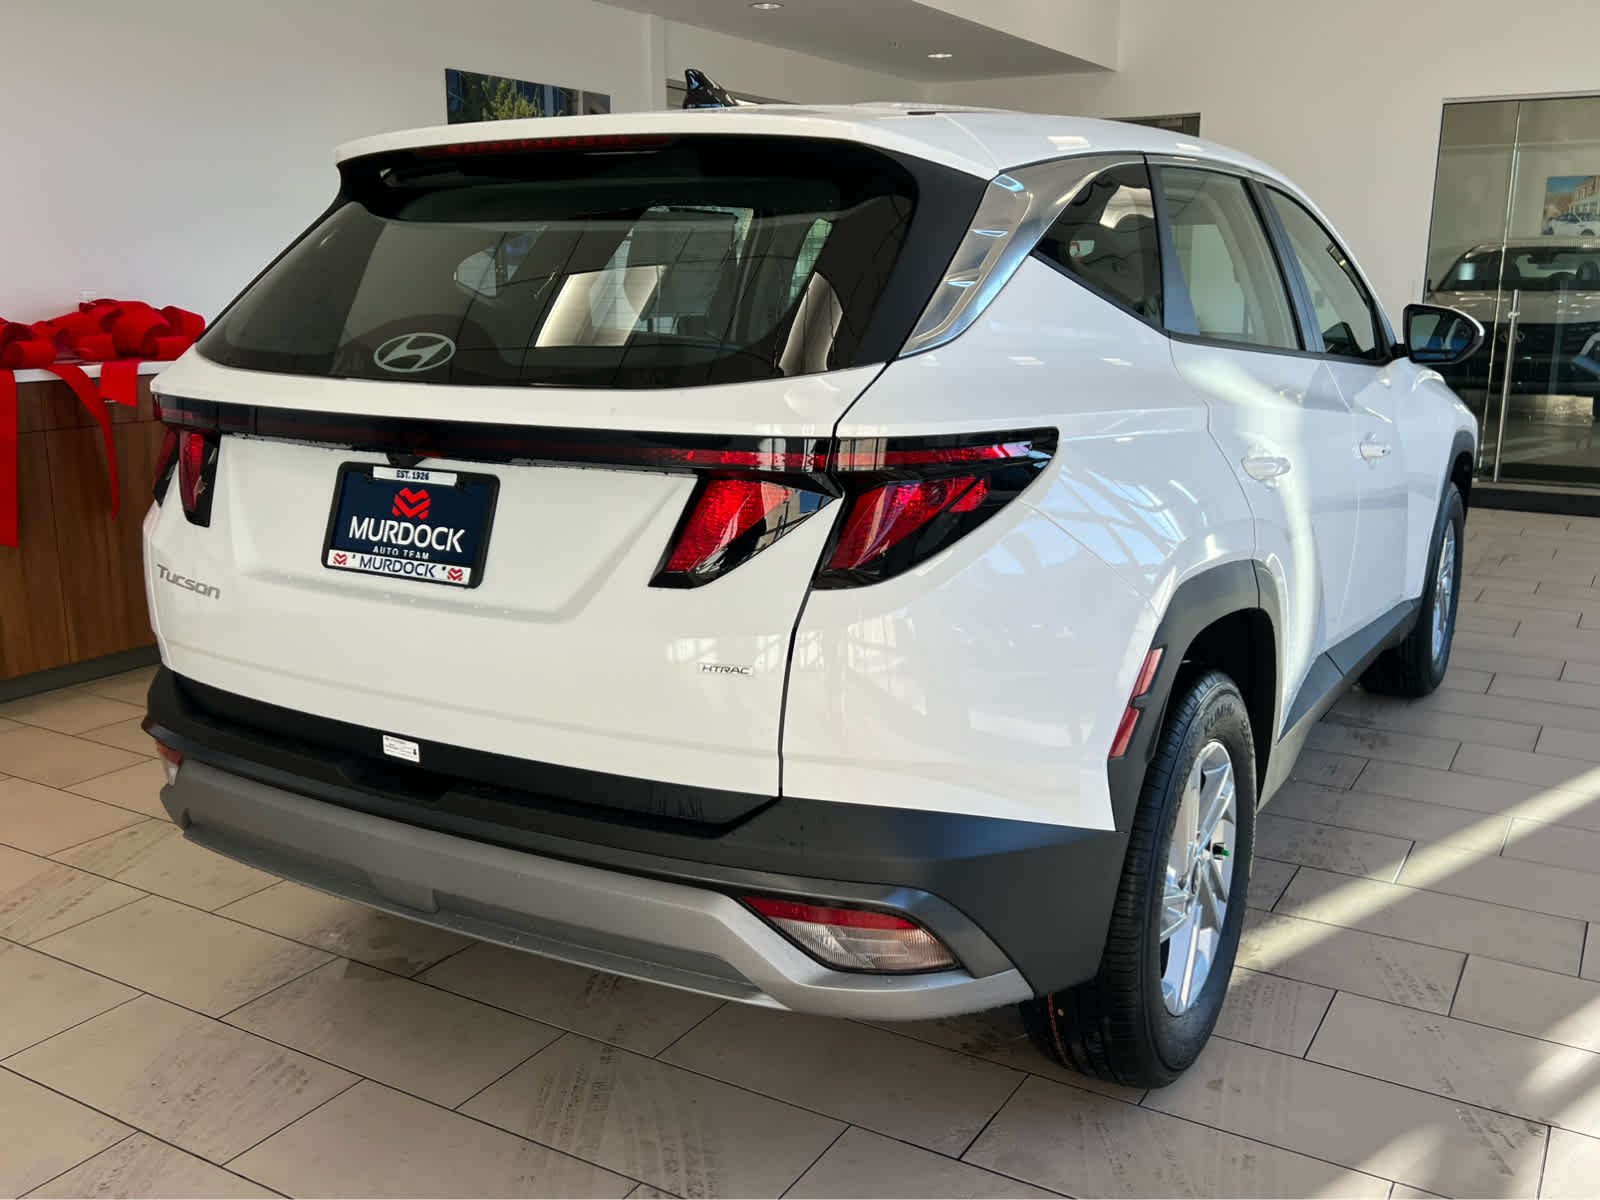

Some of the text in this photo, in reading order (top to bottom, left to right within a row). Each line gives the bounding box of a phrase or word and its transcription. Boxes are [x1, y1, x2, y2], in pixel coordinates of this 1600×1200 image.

[348, 516, 465, 553] MURDOCK
[373, 545, 430, 561] AUTO TEAM
[359, 555, 438, 578] MURDOCK
[702, 664, 750, 675] HTRAC
